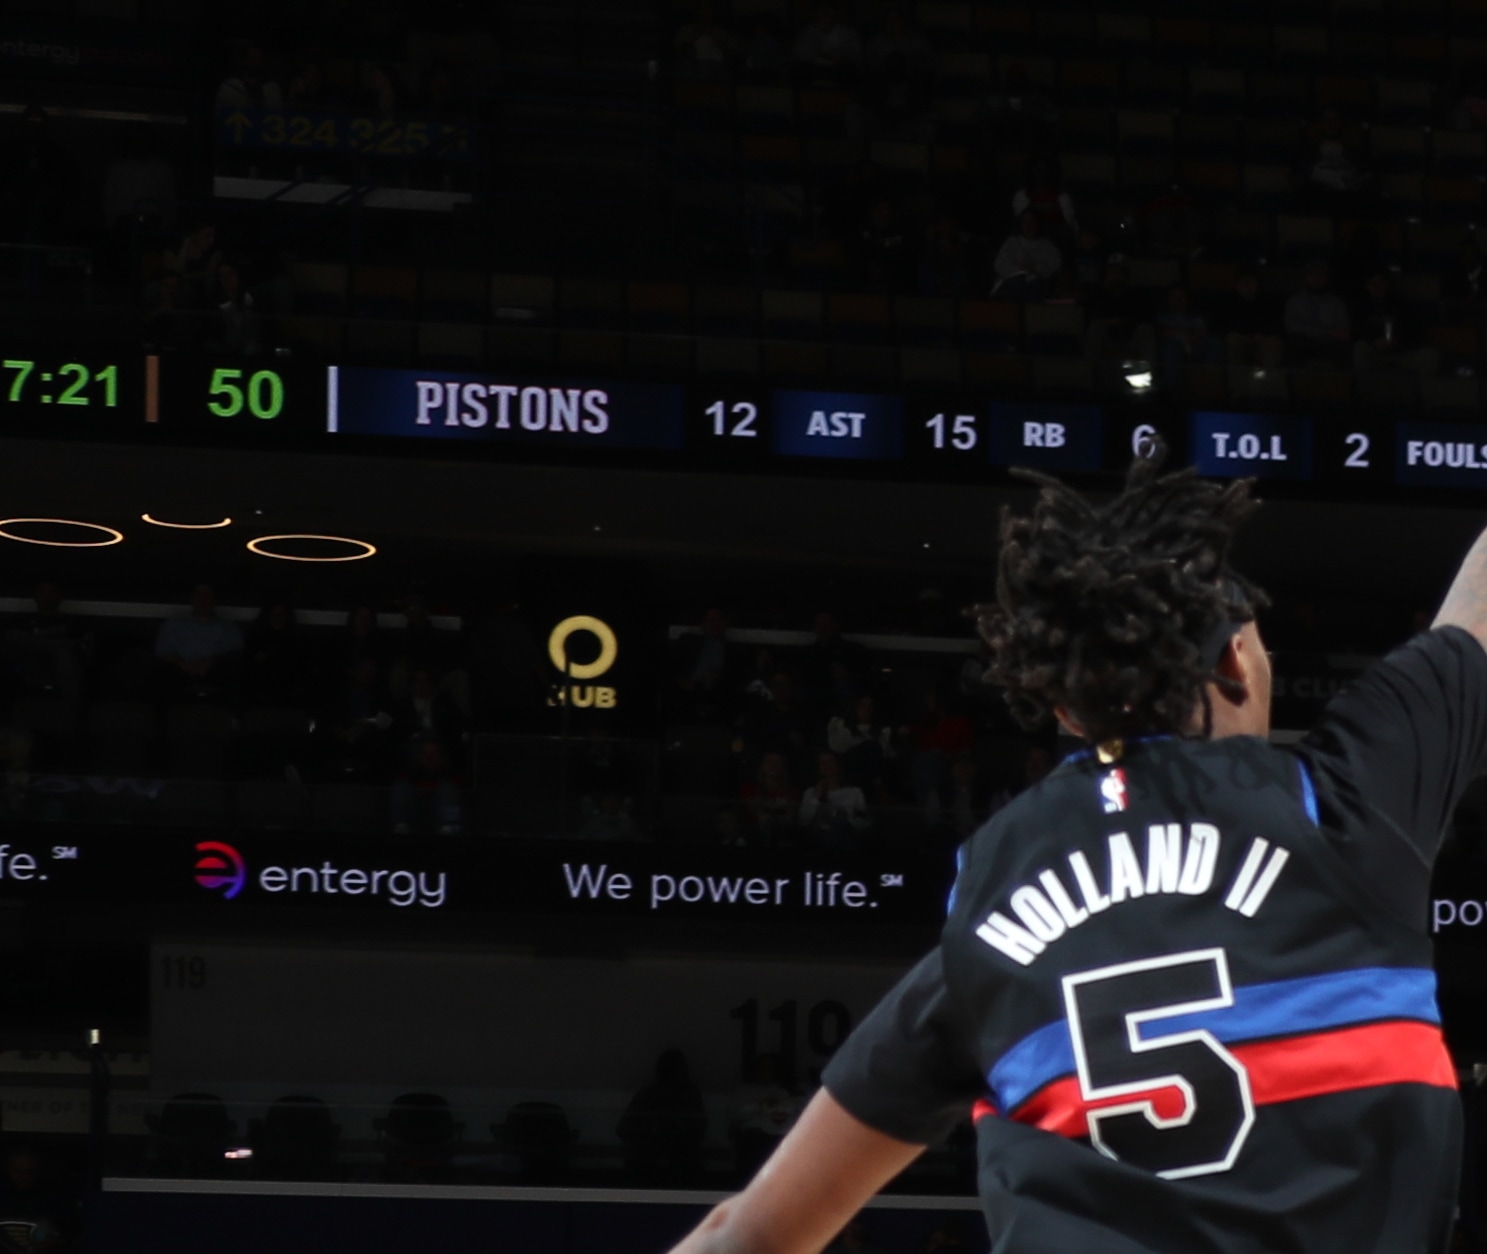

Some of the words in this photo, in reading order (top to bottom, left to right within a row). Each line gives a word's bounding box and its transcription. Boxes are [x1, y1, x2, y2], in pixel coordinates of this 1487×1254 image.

[261, 114, 339, 147] 324
[2, 359, 118, 408] 7:21
[207, 367, 285, 420] 50
[414, 379, 611, 435] PISTONS
[704, 400, 759, 439] 12
[806, 409, 868, 440] AST
[924, 412, 978, 451] 15
[1022, 420, 1067, 450] RB
[1210, 432, 1288, 462] T.O.L
[1342, 431, 1371, 469] 2
[258, 859, 448, 909] entergy
[561, 861, 635, 901] We
[650, 872, 792, 910] power
[975, 822, 1221, 967] HOLLAND
[159, 955, 208, 991] 119
[1060, 946, 1257, 1181] 5
